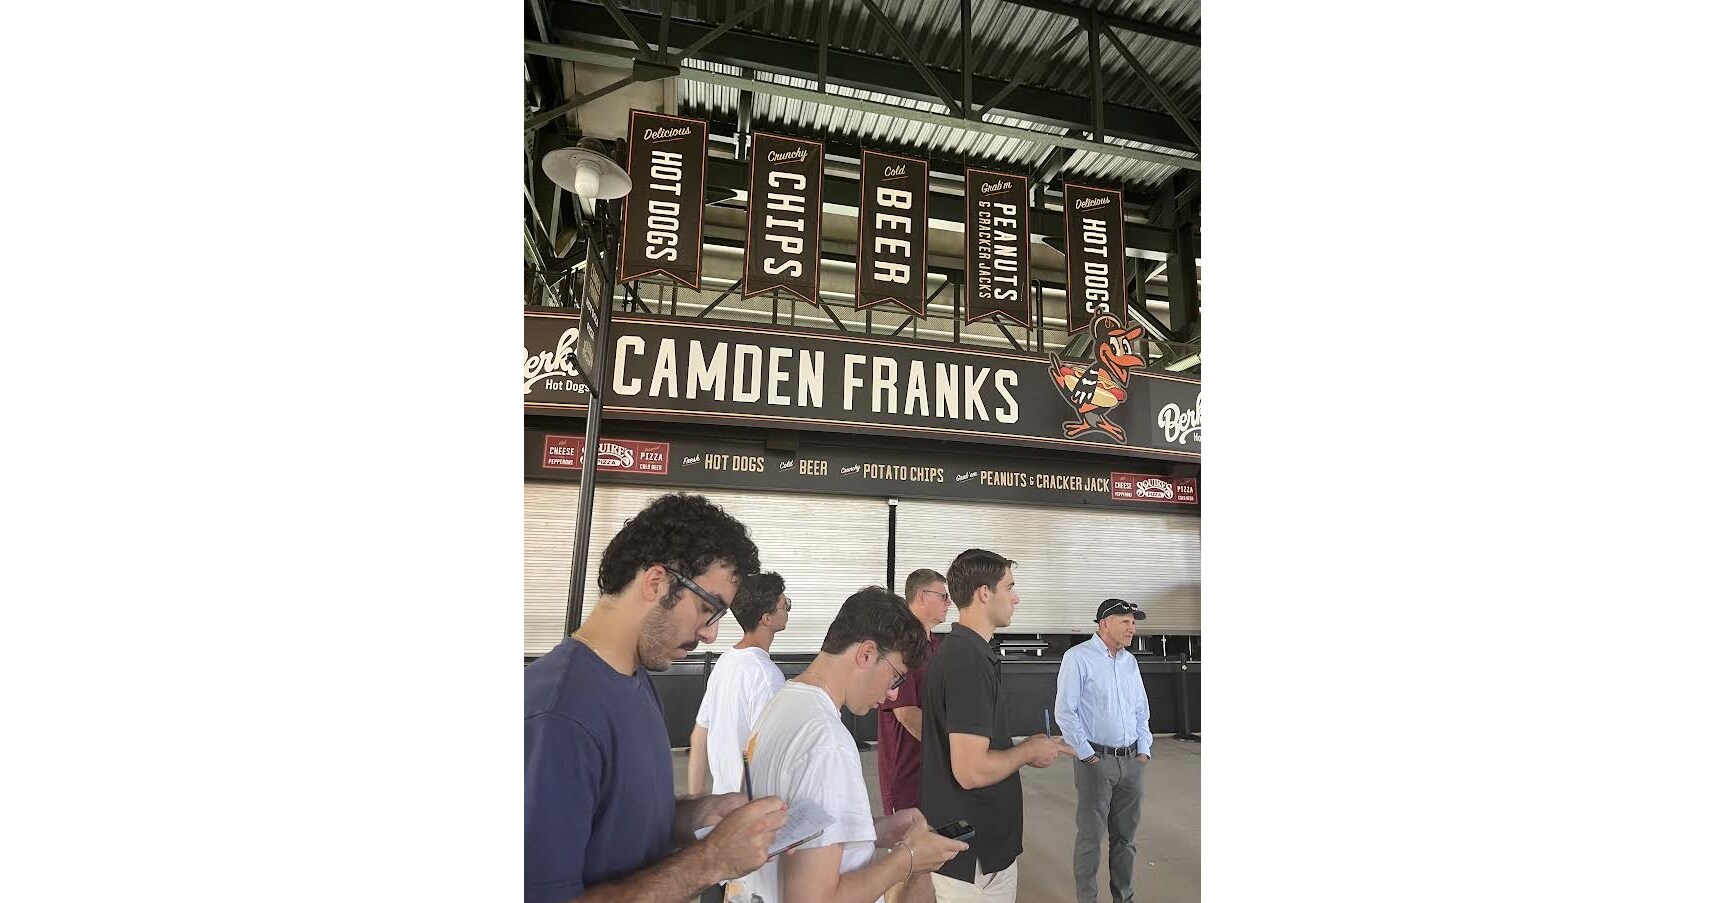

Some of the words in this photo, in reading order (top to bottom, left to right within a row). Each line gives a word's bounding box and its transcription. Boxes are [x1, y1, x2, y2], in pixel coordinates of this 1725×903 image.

[643, 126, 692, 140] Delicious
[767, 147, 808, 162] Crunchy
[649, 150, 683, 196] HOT
[884, 165, 905, 177] Cold
[1075, 196, 1111, 209] Delicious
[645, 200, 680, 262] DOGS
[763, 171, 806, 278] CHIPS
[874, 187, 912, 285] BEER
[978, 211, 991, 260] CRACKER
[1082, 217, 1108, 258] HOT
[993, 202, 1018, 301] PEANUTS
[978, 263, 992, 299] JACKS
[1084, 261, 1110, 314] DOGS
[545, 378, 564, 391] Hot
[612, 335, 825, 408] CAMDEN
[843, 353, 1019, 425] FRANKS
[549, 446, 575, 456] CHEESE
[640, 452, 663, 462] PIZZA
[704, 453, 730, 470] HOT
[732, 455, 765, 473] DOGS
[779, 460, 794, 470] Cold
[799, 459, 828, 476] BEER
[863, 463, 907, 481] POTATO
[910, 466, 944, 483] CHIPS
[980, 470, 1027, 488] PEANUTS
[1037, 473, 1082, 491] CRACKER
[1084, 477, 1110, 493] JACK
[1114, 481, 1133, 490] CHEESE
[1176, 485, 1194, 494] PIZZA
